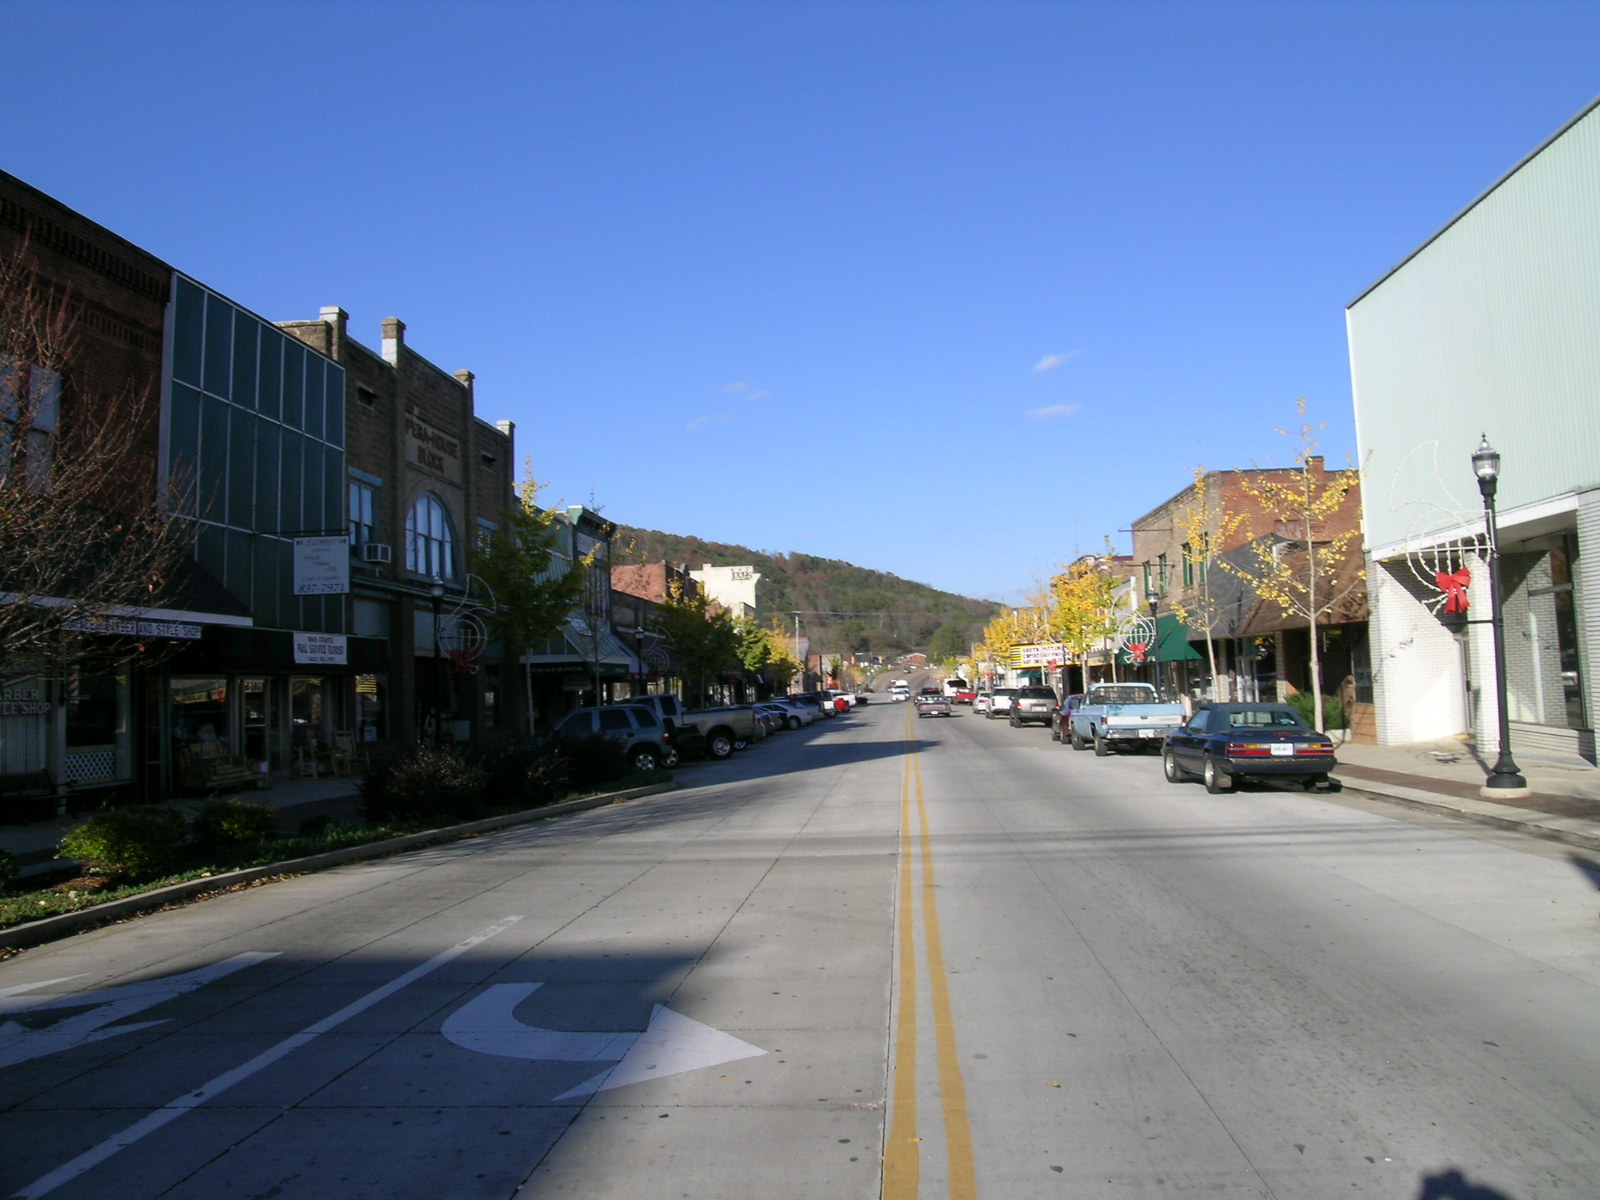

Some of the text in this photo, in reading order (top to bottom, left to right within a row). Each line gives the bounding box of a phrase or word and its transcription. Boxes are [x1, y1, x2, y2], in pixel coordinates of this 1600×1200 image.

[417, 445, 445, 474] BLOCK
[157, 624, 179, 636] STYLE
[183, 625, 200, 637] SHOP
[21, 702, 52, 715] SHOP
